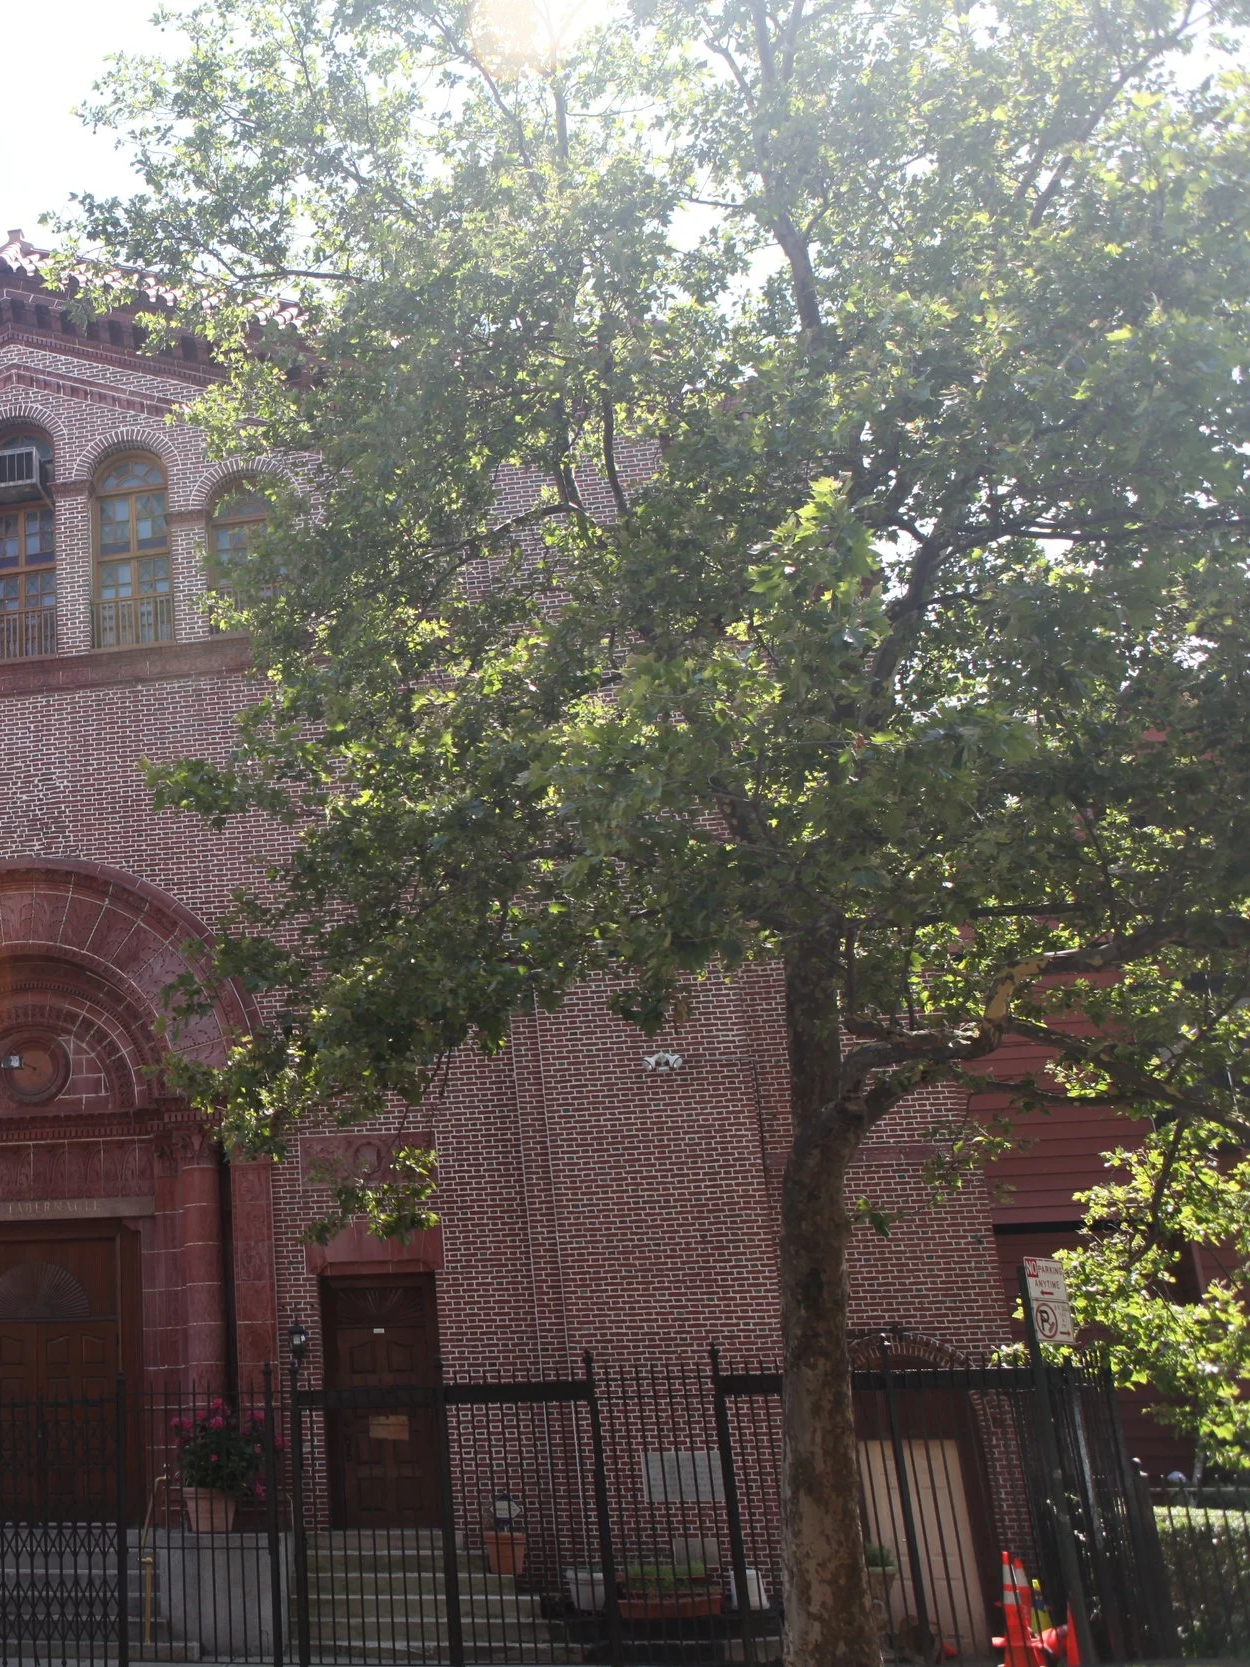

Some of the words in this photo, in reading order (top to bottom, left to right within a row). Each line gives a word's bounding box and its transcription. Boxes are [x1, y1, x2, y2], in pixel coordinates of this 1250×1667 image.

[1025, 1260, 1038, 1275] NO
[1038, 1265, 1063, 1275] PARKING
[1035, 1279, 1060, 1290] ANYTIME
